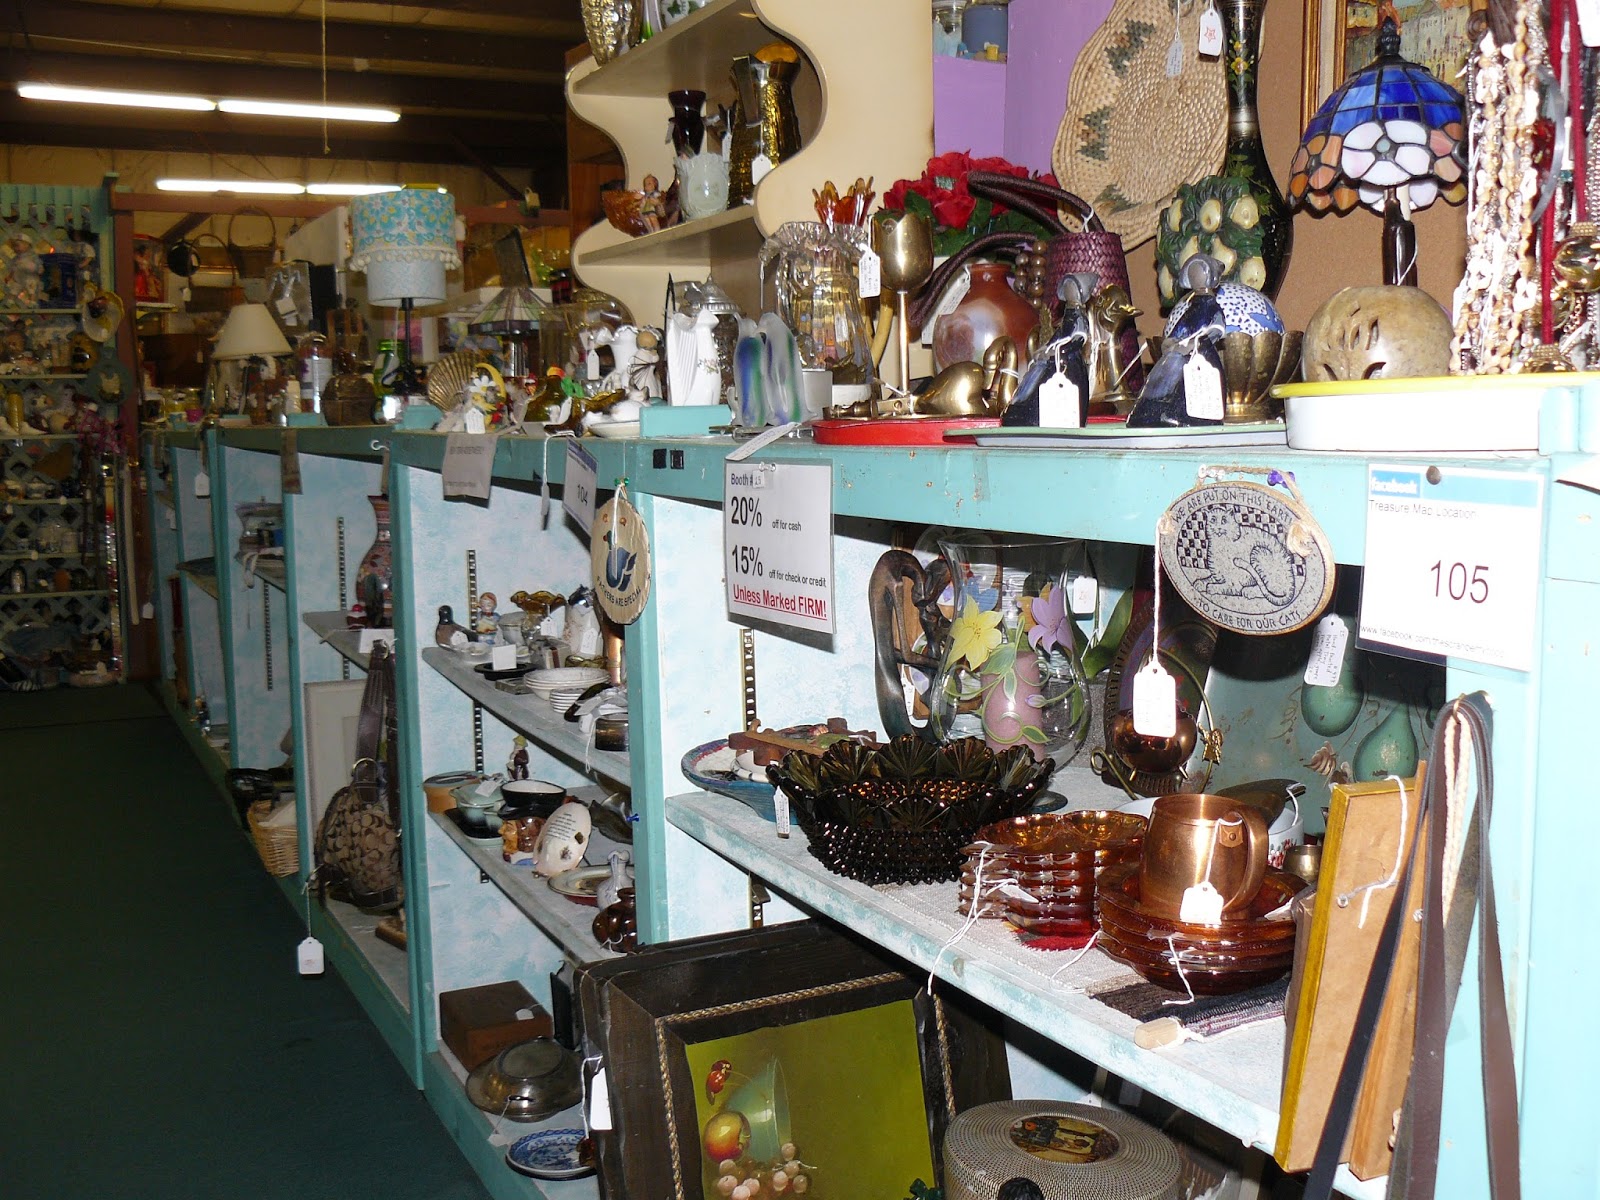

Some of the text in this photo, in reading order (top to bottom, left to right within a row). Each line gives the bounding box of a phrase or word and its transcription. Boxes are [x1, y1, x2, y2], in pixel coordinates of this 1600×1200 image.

[577, 483, 588, 506] 104
[731, 473, 749, 486] Booth
[731, 496, 762, 527] 20%
[1170, 507, 1187, 523] WE
[1187, 496, 1202, 512] ARE
[1203, 490, 1219, 503] PUT
[1222, 489, 1237, 500] ON
[1239, 492, 1262, 506] THIS
[1369, 499, 1410, 514] Treasure
[1436, 506, 1477, 520] Location
[772, 519, 801, 531] off for cash
[732, 545, 763, 576] 15%
[777, 570, 785, 580] for
[785, 571, 801, 583] check
[802, 576, 808, 584] or
[1430, 560, 1489, 604] 105
[733, 583, 827, 617] Unless Marked FIRM!
[1199, 598, 1301, 629] TO CARE FOR OUR CATS
